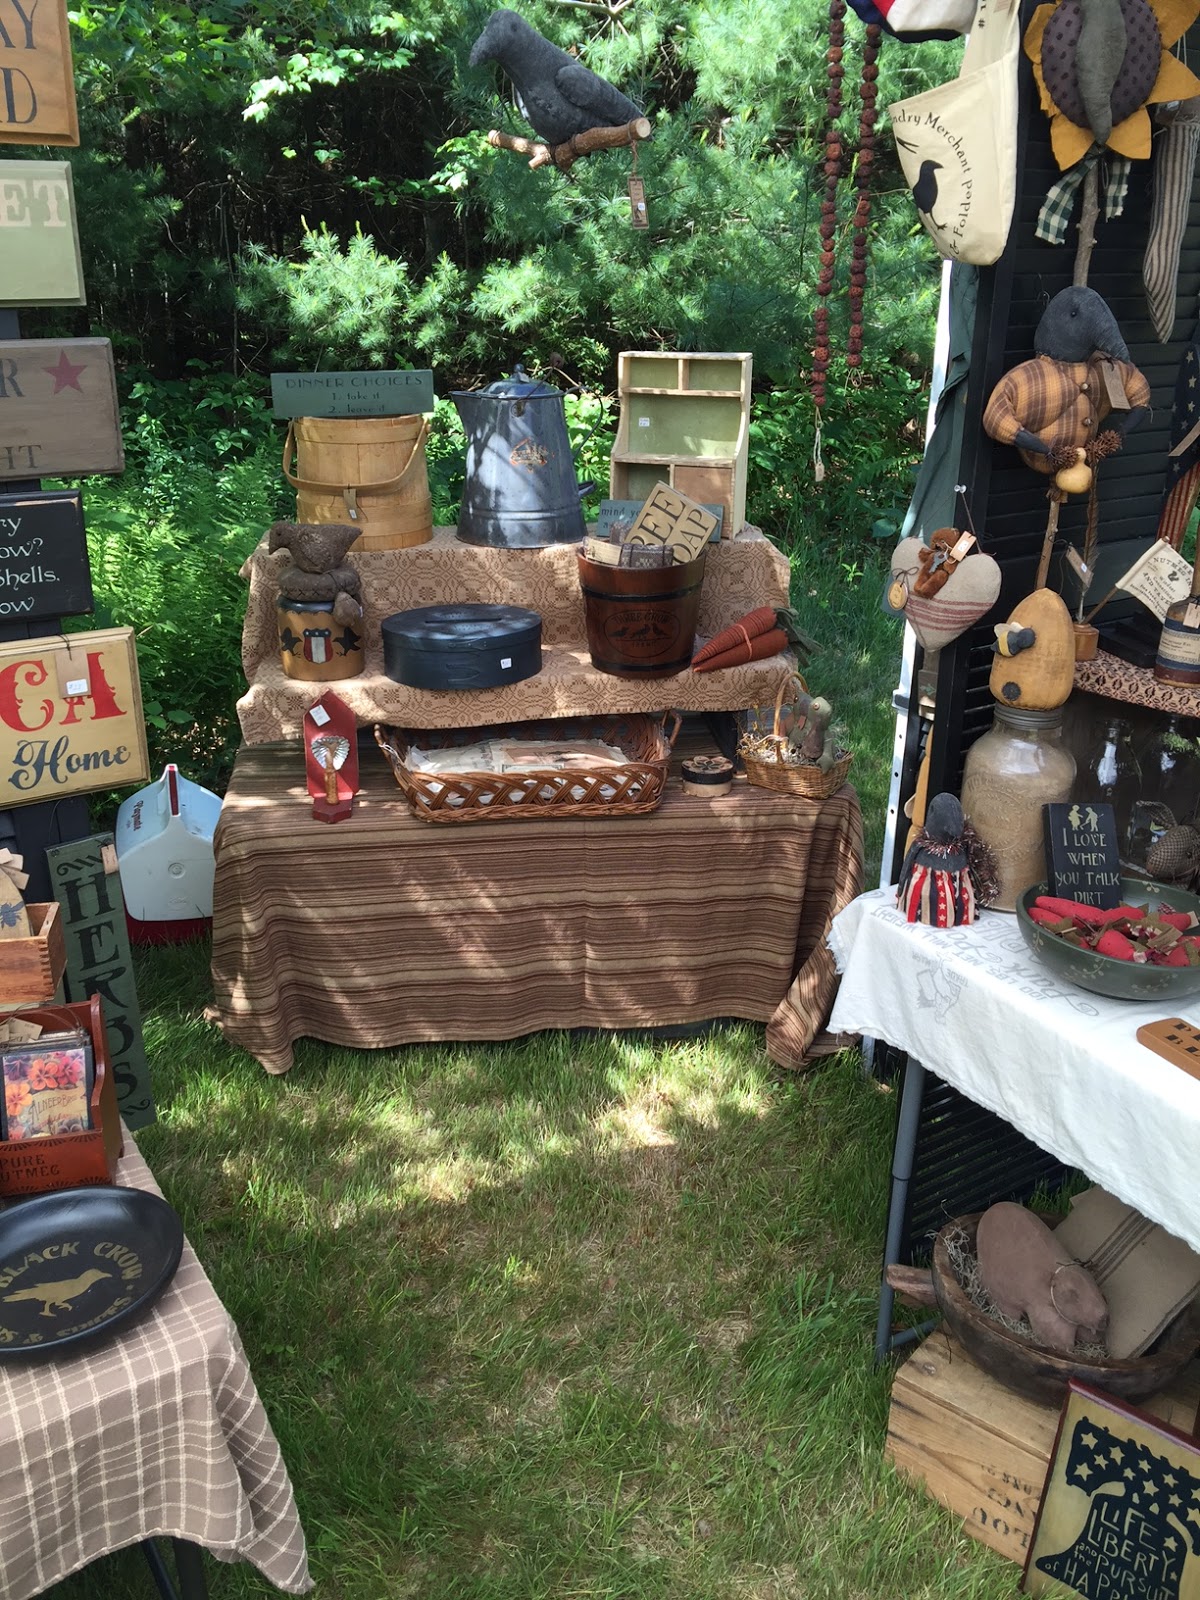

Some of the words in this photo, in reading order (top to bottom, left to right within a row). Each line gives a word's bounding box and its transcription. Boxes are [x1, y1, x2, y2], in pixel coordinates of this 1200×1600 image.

[924, 112, 972, 173] Merchant
[953, 178, 973, 238] Folded
[286, 376, 344, 390] DINNER
[351, 375, 423, 388] CHOICES
[347, 391, 369, 400] take
[373, 392, 380, 400] it
[347, 404, 375, 414] leave
[379, 404, 386, 412] it
[601, 506, 625, 516] mind
[0, 537, 43, 559] ow?
[1153, 557, 1187, 577] NUTMEG
[1177, 560, 1193, 576] THE
[0, 596, 35, 615] ow
[8, 735, 131, 791] Home
[1062, 828, 1068, 847] I
[1073, 833, 1107, 847] LOVE
[1067, 852, 1106, 866] WHEN
[1055, 871, 1079, 887] YOU
[1085, 871, 1120, 886] TALK
[1073, 891, 1104, 905] DIRT
[922, 931, 953, 949] MILL
[951, 951, 981, 967] NET
[0, 1153, 46, 1170] PURE
[93, 1241, 143, 1281] CROW
[1101, 1501, 1158, 1552] LIFE
[1087, 1508, 1176, 1583] LIBERTY
[1044, 1561, 1060, 1574] of
[1095, 1553, 1176, 1600] PURSUIT
